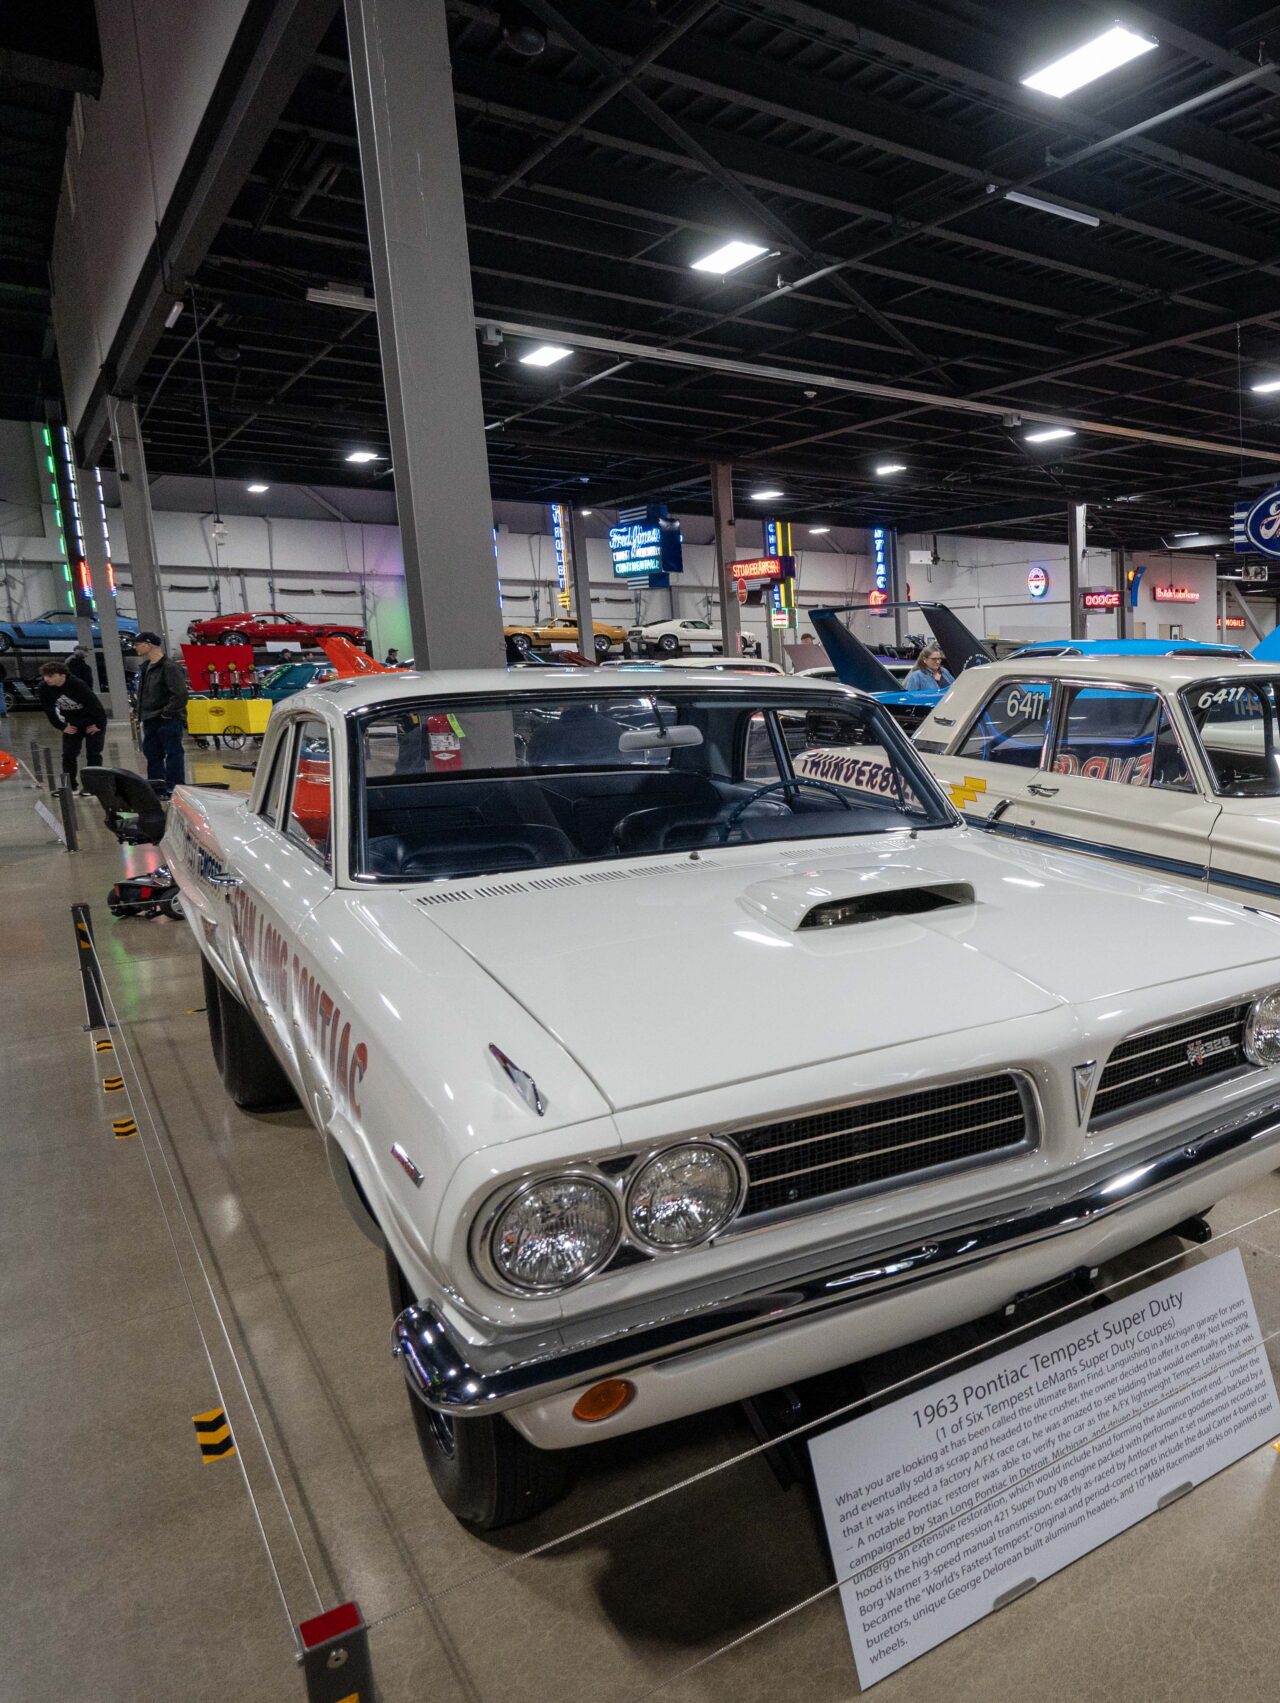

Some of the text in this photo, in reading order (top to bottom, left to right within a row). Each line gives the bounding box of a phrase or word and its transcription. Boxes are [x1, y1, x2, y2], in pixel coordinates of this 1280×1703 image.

[609, 525, 660, 553] Fred Jones
[1085, 594, 1121, 605] DODGE
[1007, 690, 1046, 721] 6411
[1198, 687, 1245, 709] 6411
[231, 886, 369, 1121] STAN LONG PONTIAC
[1205, 1036, 1231, 1053] 326
[835, 1299, 1245, 1506] What you are looking at has been called the ultimate Barn Find. Languishing in a Michigan garage for years
[913, 1292, 1183, 1428] 1963 Pontiac Tempest Super Duty
[936, 1316, 1175, 1443] (1 of Six Tempest LeMans Super Duty Coupes)
[849, 1474, 1018, 1569] campaigned by Stan Long Pontiac in
[859, 1576, 921, 1617] Borg-Warner
[924, 1551, 961, 1580] 3-speed
[963, 1531, 996, 1558] manual
[997, 1502, 1053, 1538] transmission;
[1054, 1485, 1082, 1506] exactly
[1084, 1465, 1116, 1490] as-raced
[1116, 1461, 1126, 1471] by
[1158, 1430, 1179, 1446] when
[1179, 1426, 1185, 1434] it
[1185, 1419, 1196, 1431] set
[1197, 1402, 1230, 1424] numerous
[1230, 1387, 1253, 1405] records
[1254, 1378, 1266, 1392] and
[862, 1604, 903, 1632] became
[904, 1594, 921, 1608] the
[961, 1552, 992, 1575] Fastest
[1034, 1507, 1067, 1533] Original
[1068, 1498, 1084, 1514] and
[1084, 1468, 1138, 1506] period-correct
[1139, 1457, 1158, 1475] parts
[1158, 1442, 1184, 1461] include
[1184, 1435, 1196, 1446] the
[1197, 1424, 1212, 1439] dual
[1212, 1413, 1232, 1429] Carter
[1233, 1397, 1257, 1416] 4-barrel
[1257, 1393, 1269, 1403] car-
[866, 1618, 911, 1648] buretors,
[912, 1597, 946, 1621] unique
[947, 1576, 981, 1600] George
[1023, 1538, 1043, 1556] built
[1045, 1514, 1086, 1544] aluminum
[1086, 1496, 1119, 1519] headers,
[1120, 1484, 1134, 1499] and
[1147, 1466, 1166, 1482] M&H
[1166, 1444, 1205, 1471] Racemaster
[1206, 1433, 1223, 1447] slicks
[1223, 1427, 1233, 1437] on
[1233, 1411, 1258, 1433] painted
[1258, 1402, 1272, 1417] steel
[869, 1638, 908, 1664] wheels.
